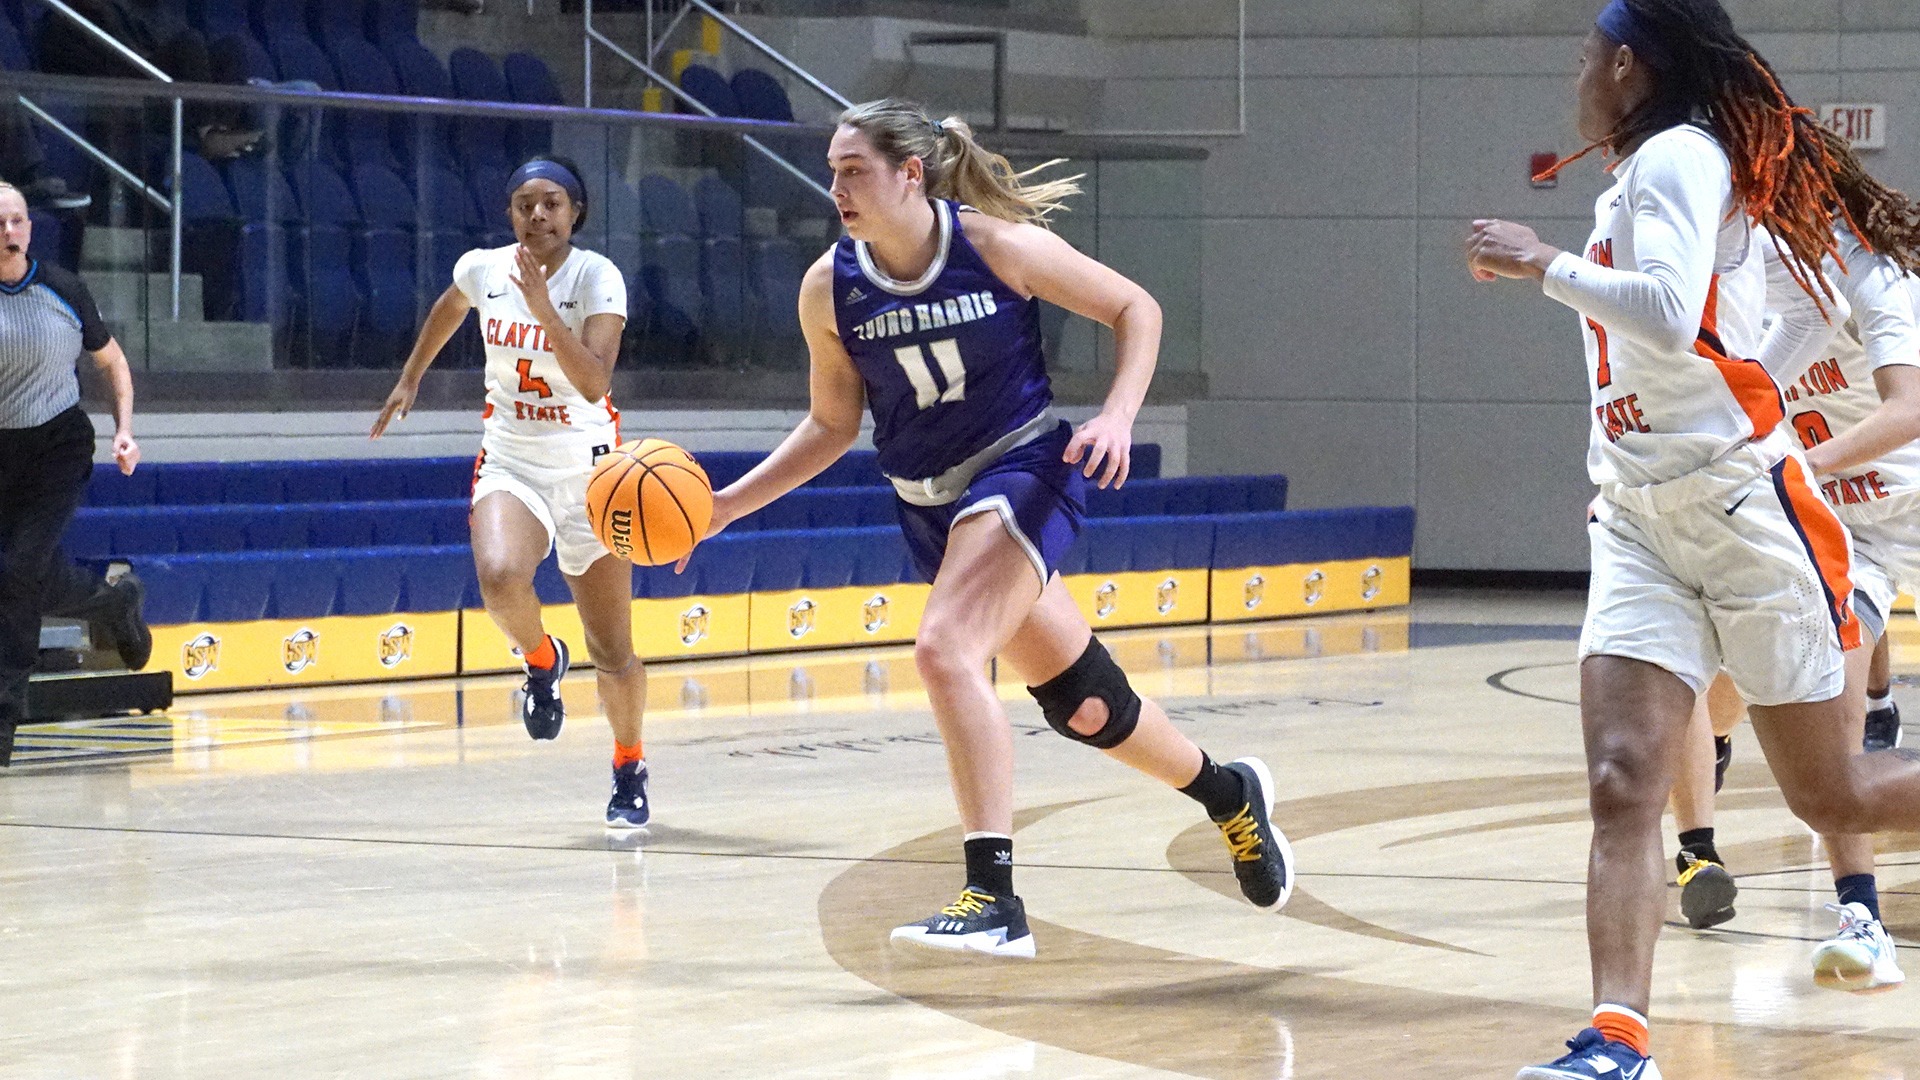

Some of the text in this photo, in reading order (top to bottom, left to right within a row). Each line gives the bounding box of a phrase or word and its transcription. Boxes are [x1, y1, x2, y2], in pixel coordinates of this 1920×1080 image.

[1833, 108, 1874, 140] EXIT
[914, 289, 997, 331] HARRIS
[487, 318, 553, 352] CLAYT
[516, 358, 553, 399] 4
[894, 338, 966, 410] 11
[514, 401, 572, 426] STATE
[1596, 393, 1651, 443] TATE
[1820, 471, 1890, 506] TATE
[184, 640, 220, 669] GSW
[284, 635, 320, 664] GSW
[379, 629, 414, 659] GSW
